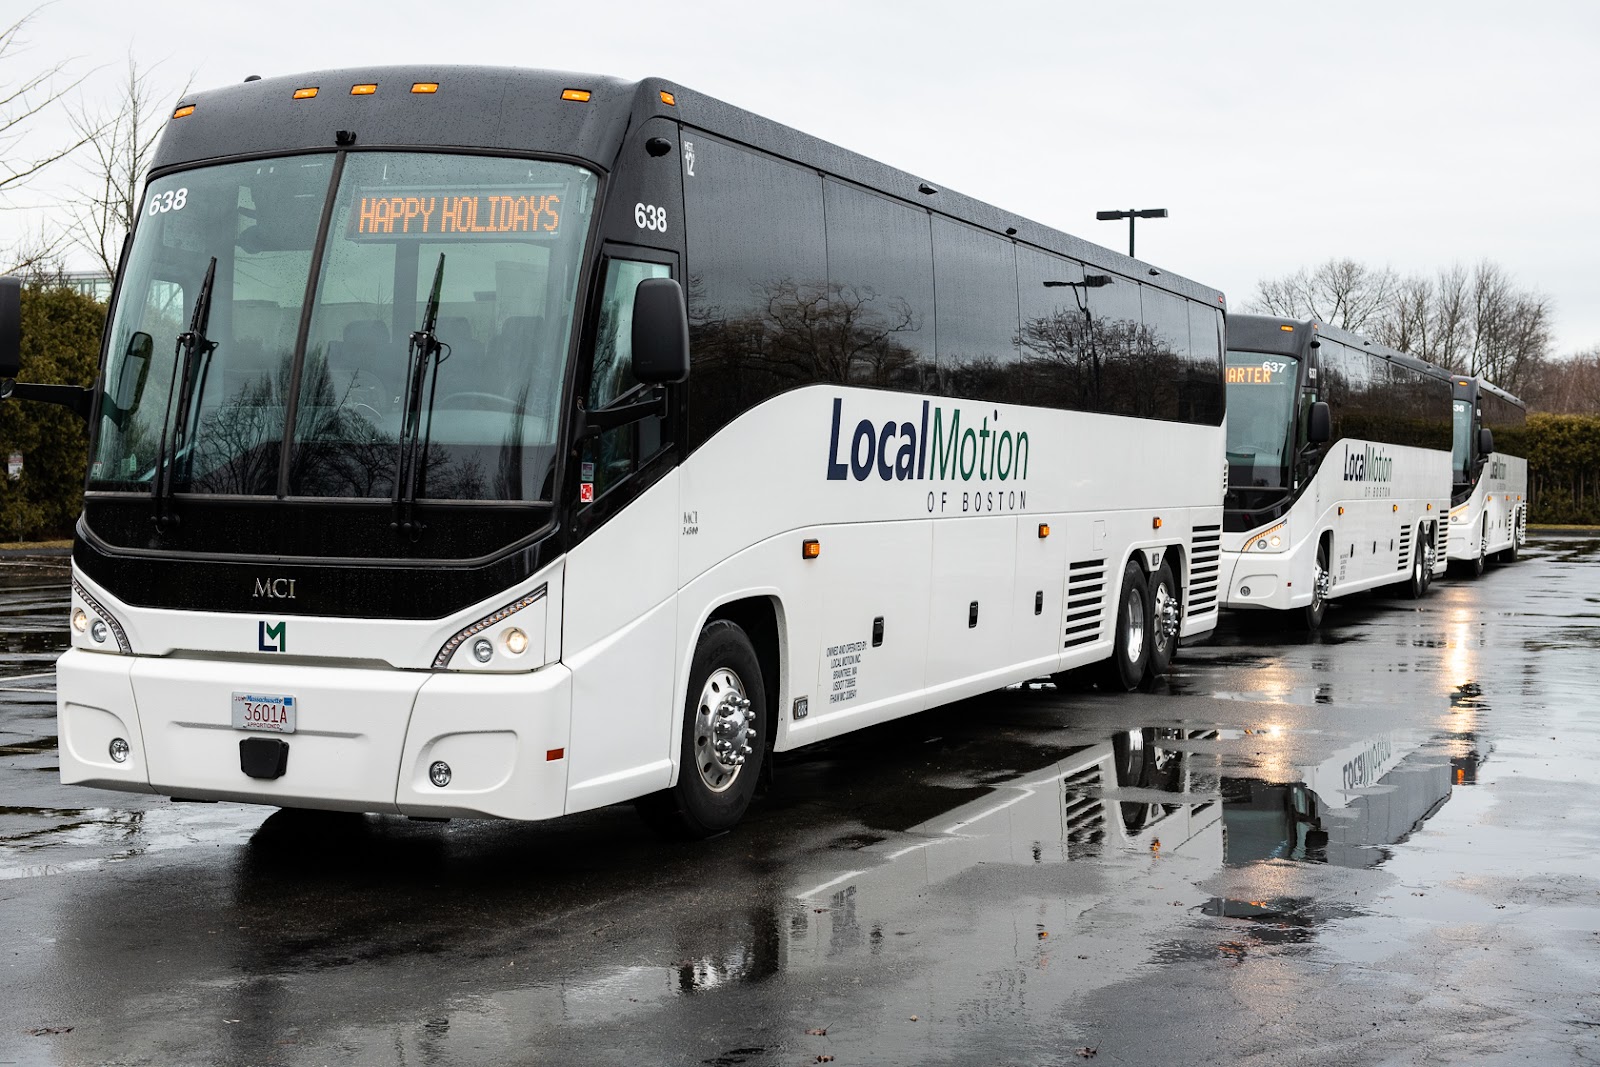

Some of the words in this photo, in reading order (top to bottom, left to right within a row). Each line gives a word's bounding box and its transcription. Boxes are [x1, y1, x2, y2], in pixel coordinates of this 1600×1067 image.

[148, 187, 189, 217] 638
[359, 197, 436, 233] HAPPY
[441, 194, 560, 233] HOLIDAYS
[634, 202, 668, 233] 638
[1262, 361, 1287, 374] 637
[927, 491, 948, 513] OF
[962, 490, 1028, 512] BOSTON
[683, 511, 698, 524] MCI
[252, 577, 296, 598] MCI
[259, 621, 286, 652] LM
[826, 646, 838, 657] OWNED
[831, 657, 842, 669] LOCAL
[842, 656, 855, 667] MOTION
[247, 695, 282, 704] Massachusetts
[244, 703, 288, 723] 3601A
